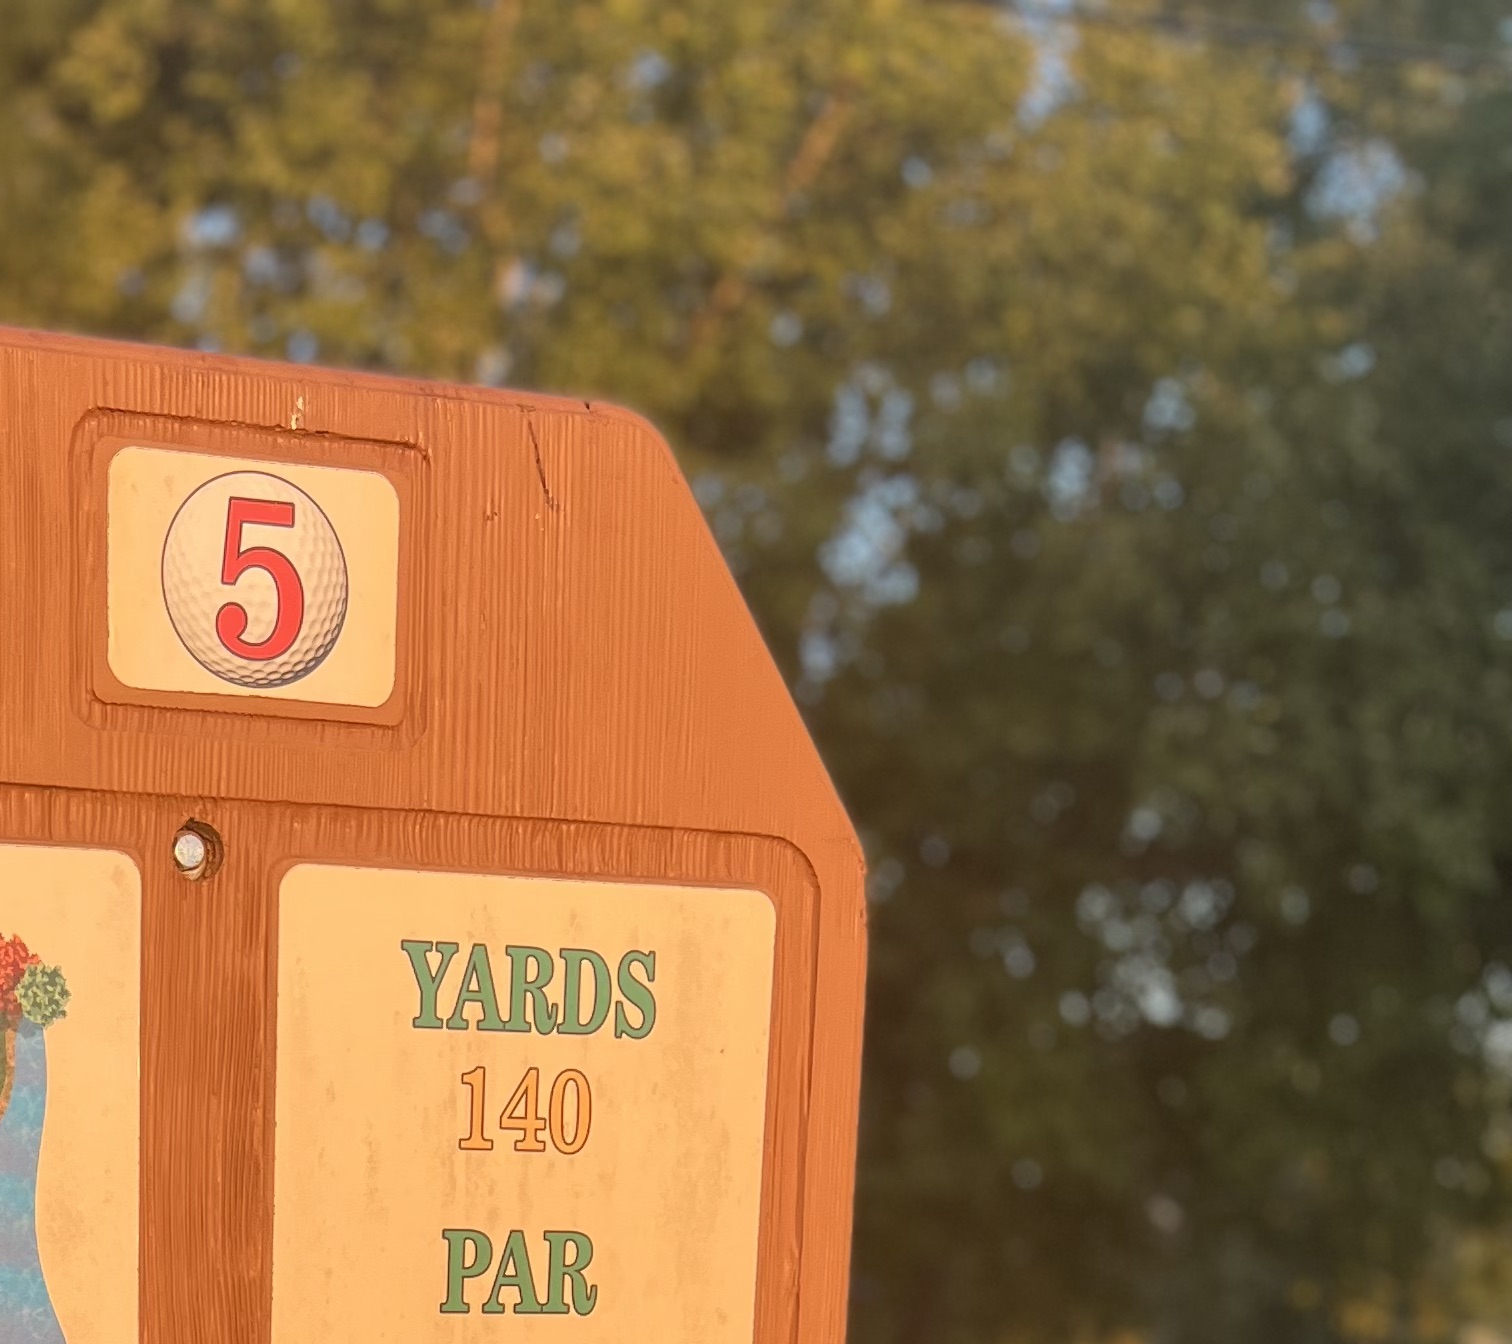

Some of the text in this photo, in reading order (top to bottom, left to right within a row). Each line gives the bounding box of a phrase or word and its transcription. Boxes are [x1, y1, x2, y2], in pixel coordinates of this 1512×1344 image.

[215, 495, 304, 661] 5
[401, 939, 657, 1039] YARDS
[458, 1066, 592, 1154] 140
[439, 1228, 598, 1316] PAR
